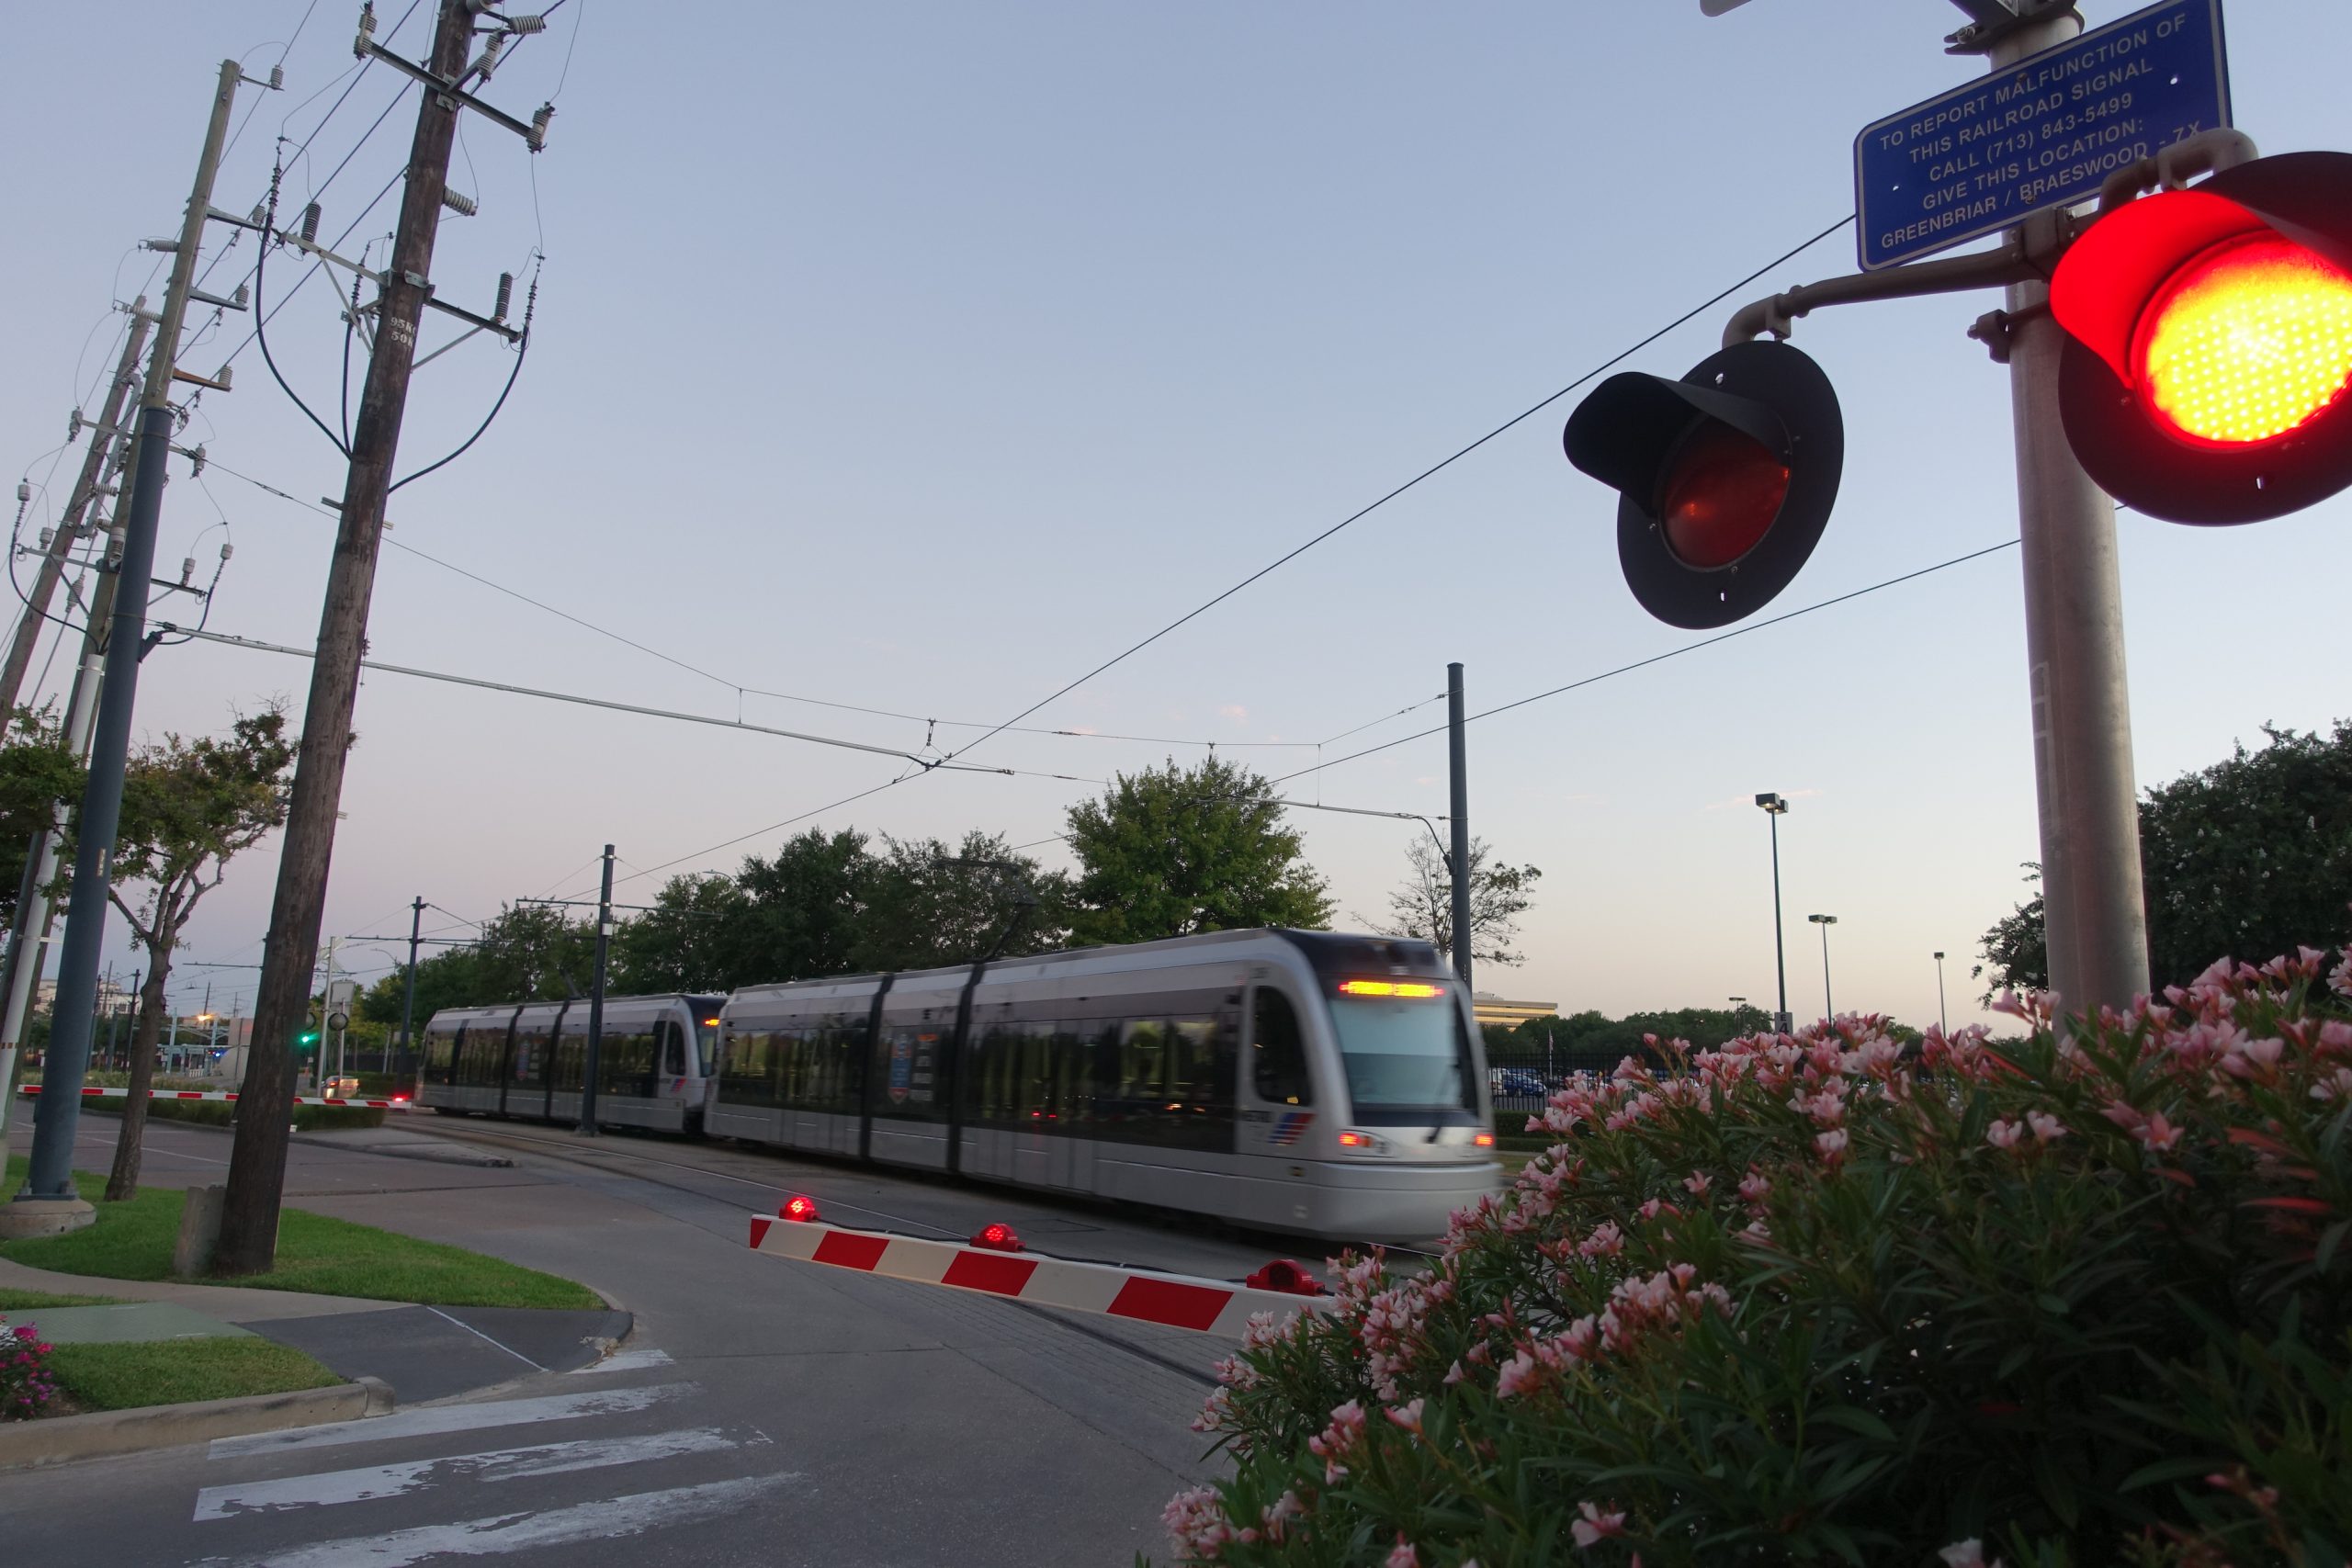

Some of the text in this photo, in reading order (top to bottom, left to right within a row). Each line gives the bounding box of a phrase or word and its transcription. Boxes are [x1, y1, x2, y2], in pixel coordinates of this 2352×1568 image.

[1880, 14, 2186, 151] TO REPORT MALFUNCTION OF
[1909, 59, 2153, 164] THIS RAILROAD SIGNAL
[1923, 118, 2143, 210] GIVE THIS LOCATION:
[1929, 93, 2132, 182] CALL (713) 843-5499
[1882, 196, 1997, 249] GREENBRIAR
[2005, 189, 2012, 207] /
[2020, 141, 2148, 201] BRAESWOOD
